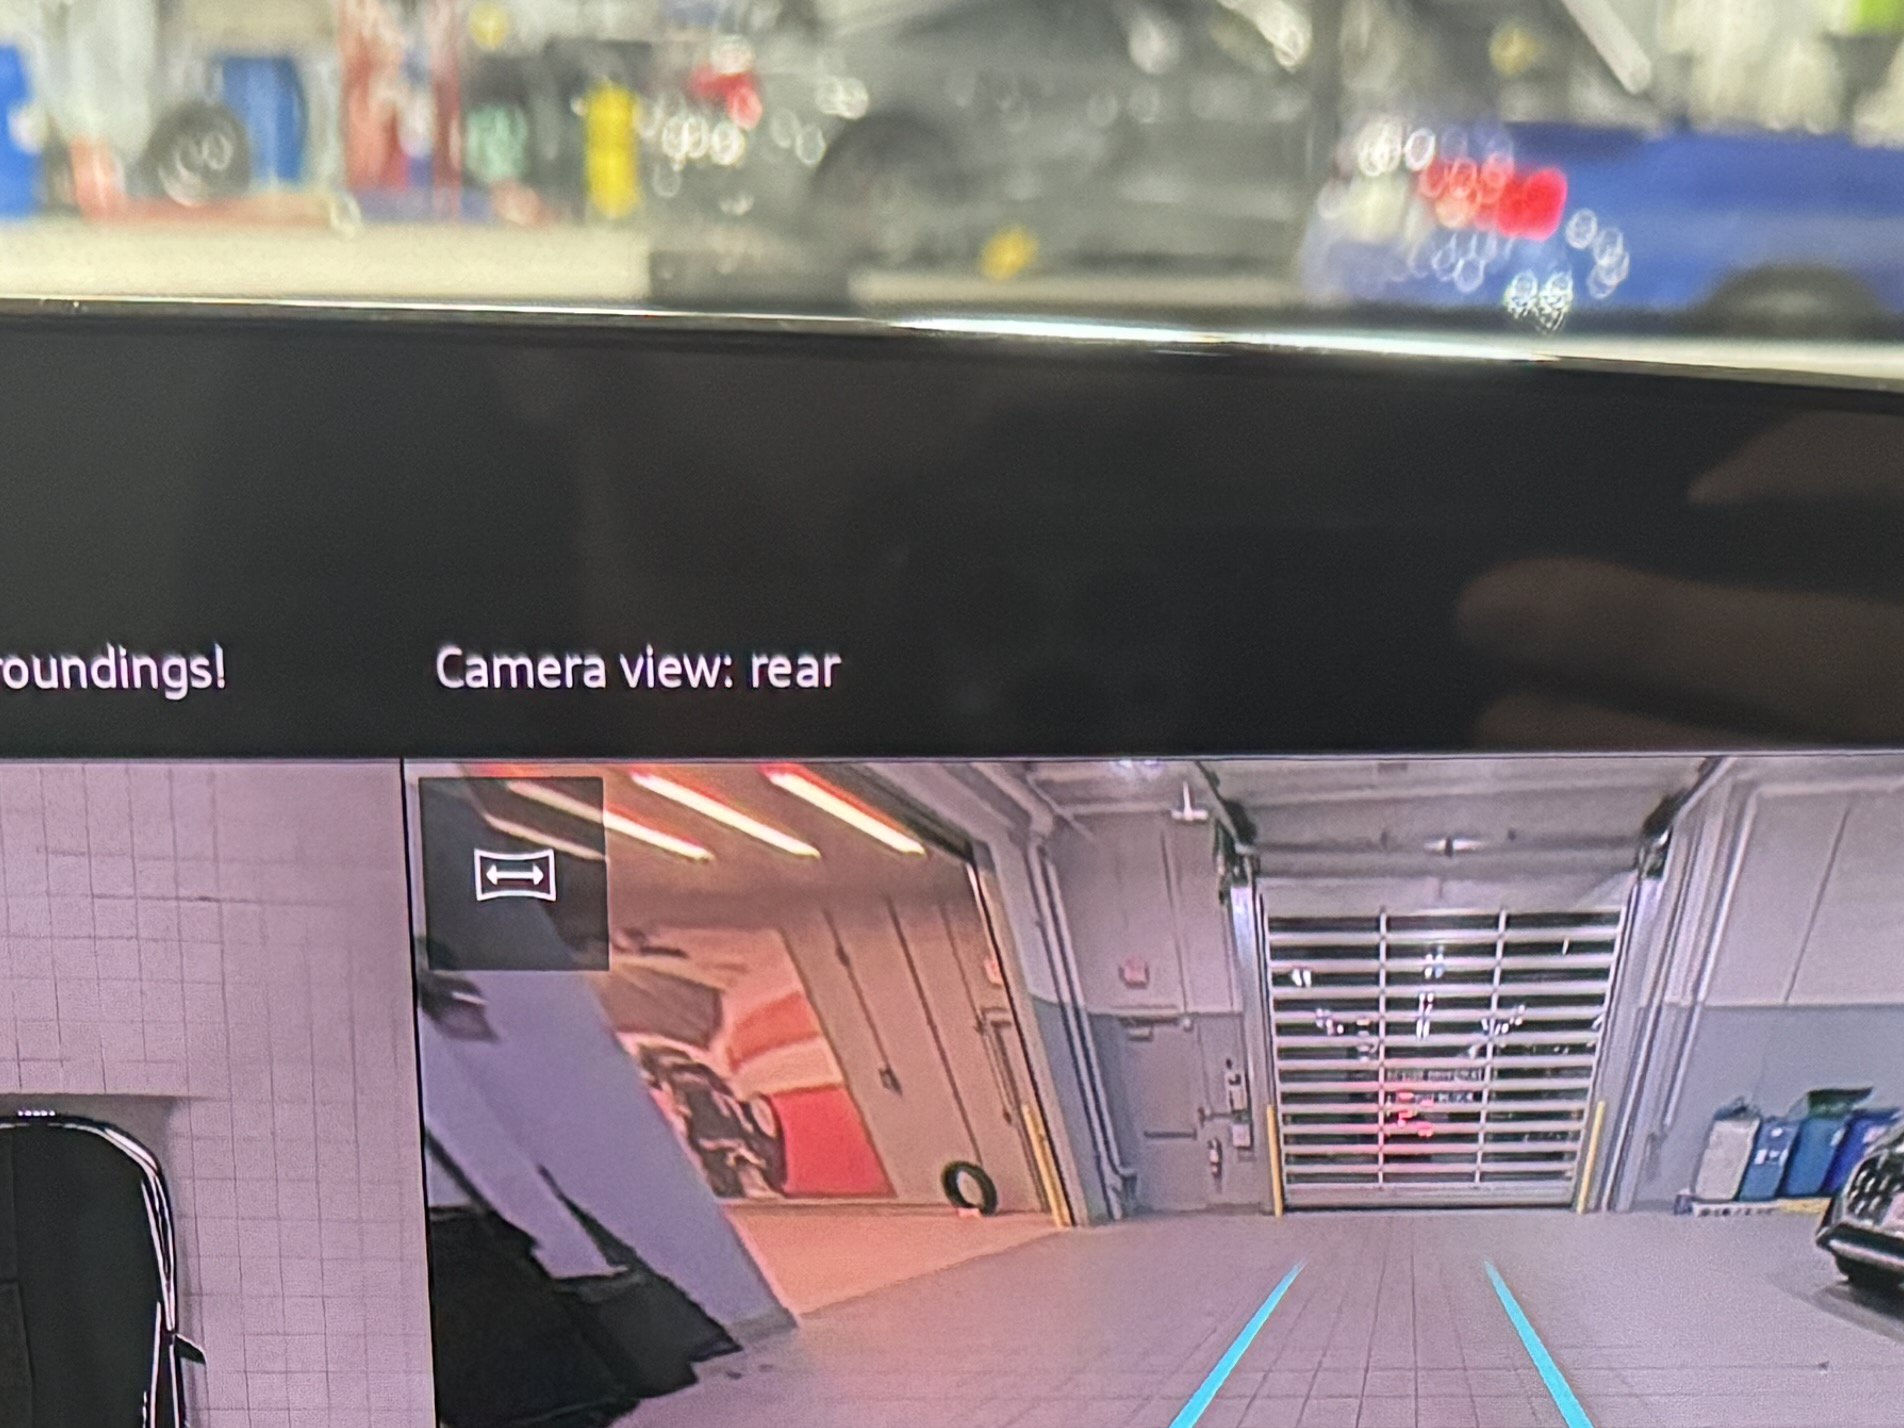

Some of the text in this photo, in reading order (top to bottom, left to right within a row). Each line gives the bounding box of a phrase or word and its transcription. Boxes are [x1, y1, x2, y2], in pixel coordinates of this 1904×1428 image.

[436, 644, 842, 690] Camera view: rear
